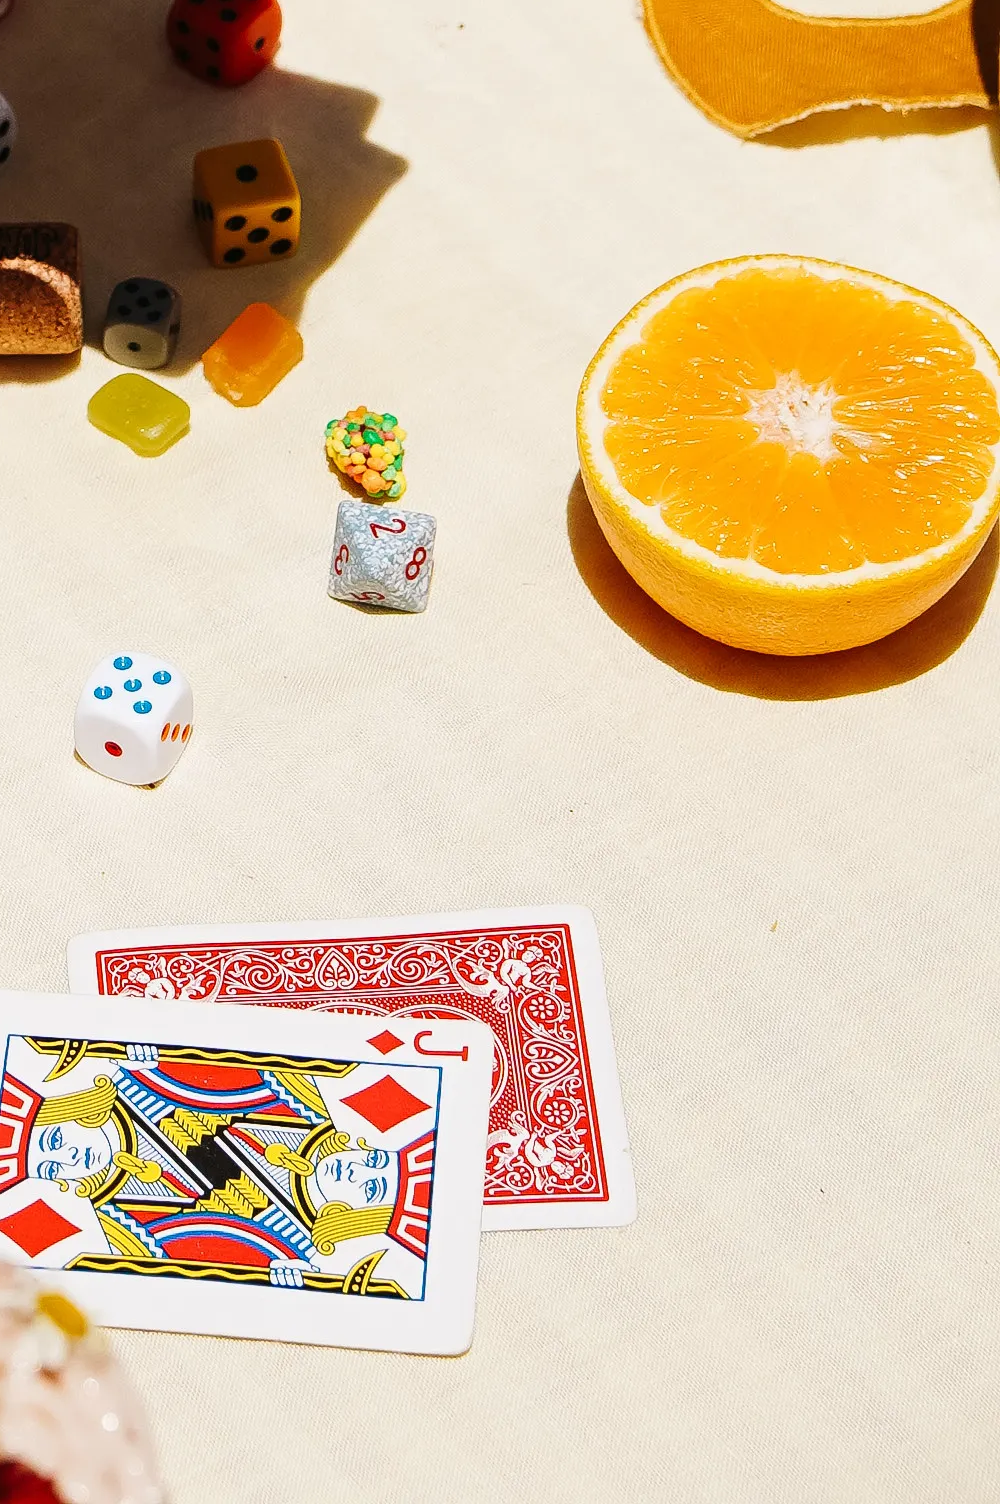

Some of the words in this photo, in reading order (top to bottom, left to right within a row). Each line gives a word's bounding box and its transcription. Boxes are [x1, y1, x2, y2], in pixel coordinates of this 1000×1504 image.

[369, 518, 407, 539] 2
[405, 547, 427, 581] 8
[413, 1030, 469, 1062] J
